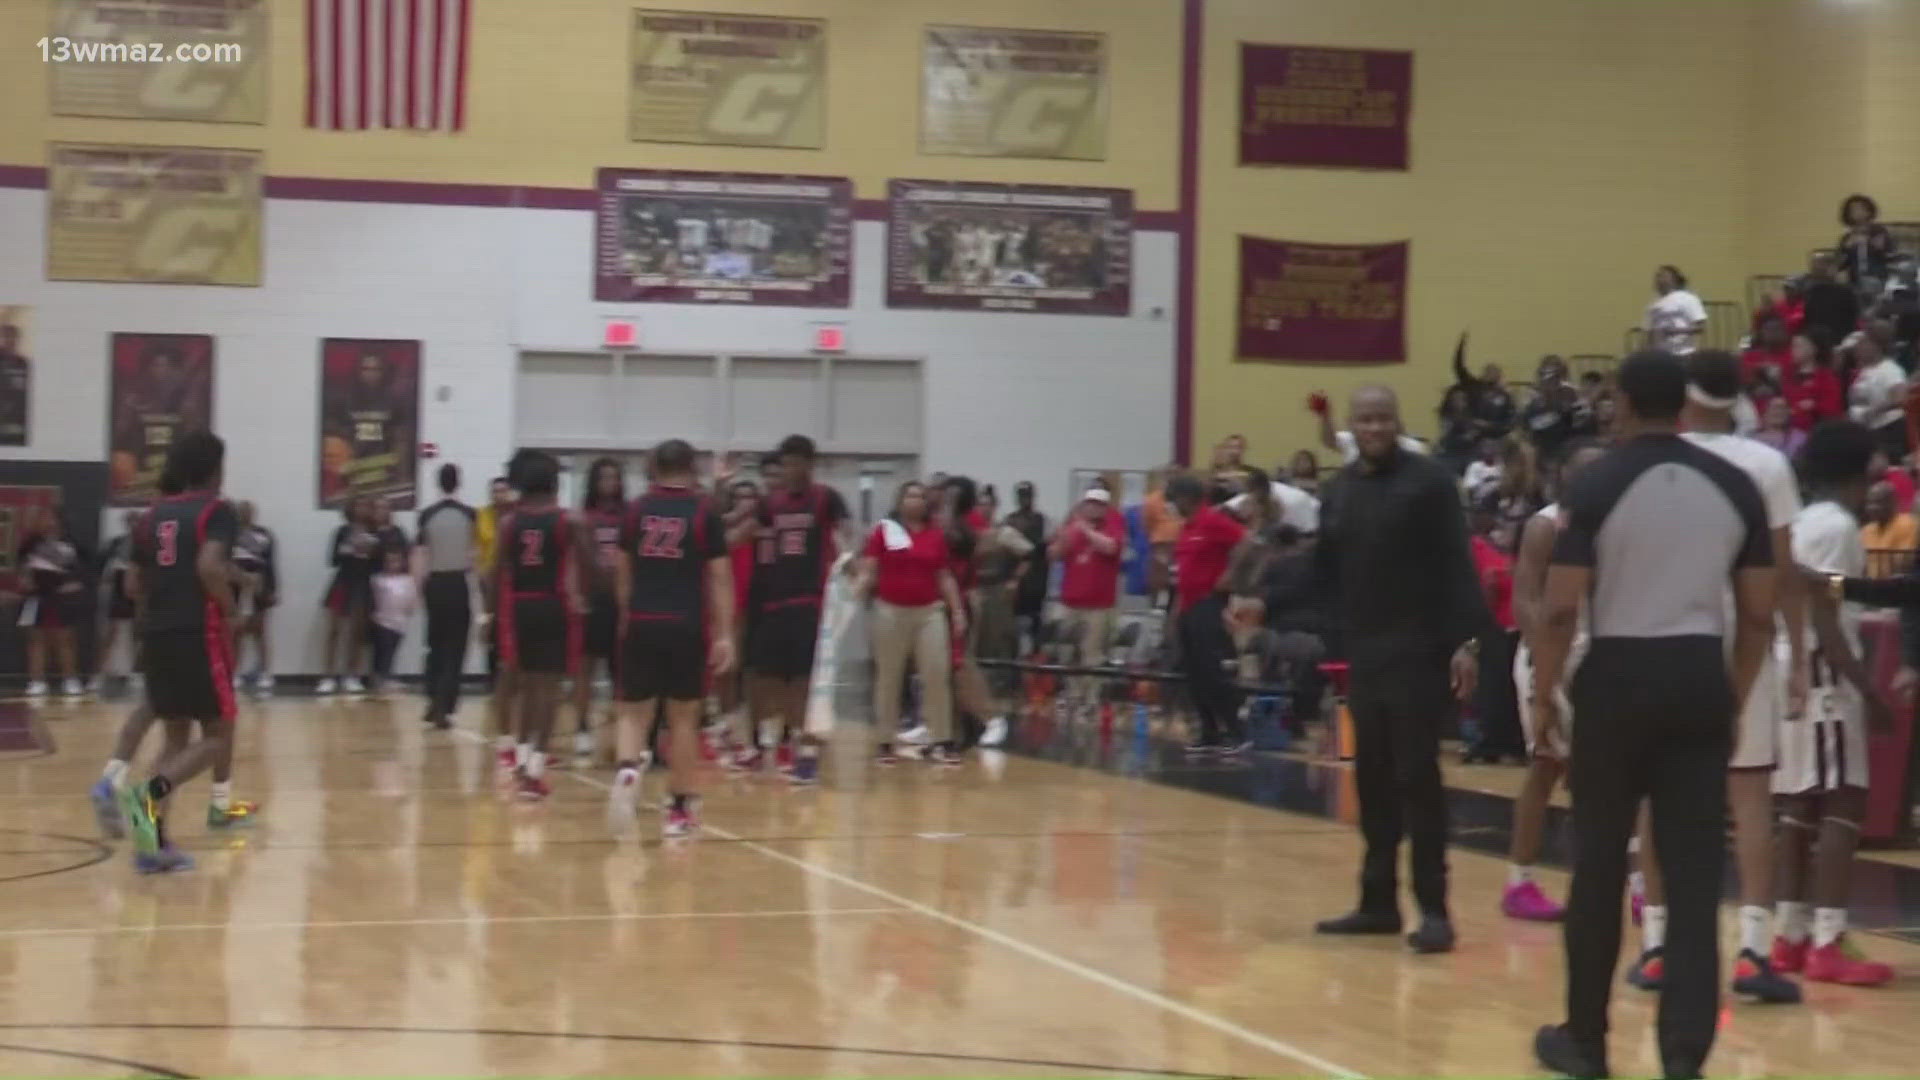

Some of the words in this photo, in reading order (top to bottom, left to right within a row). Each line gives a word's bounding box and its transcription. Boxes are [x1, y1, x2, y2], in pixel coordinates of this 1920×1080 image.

[707, 73, 811, 134] C
[994, 87, 1090, 148] C
[157, 520, 179, 565] 3
[520, 529, 544, 566] 2
[641, 515, 686, 558] 22
